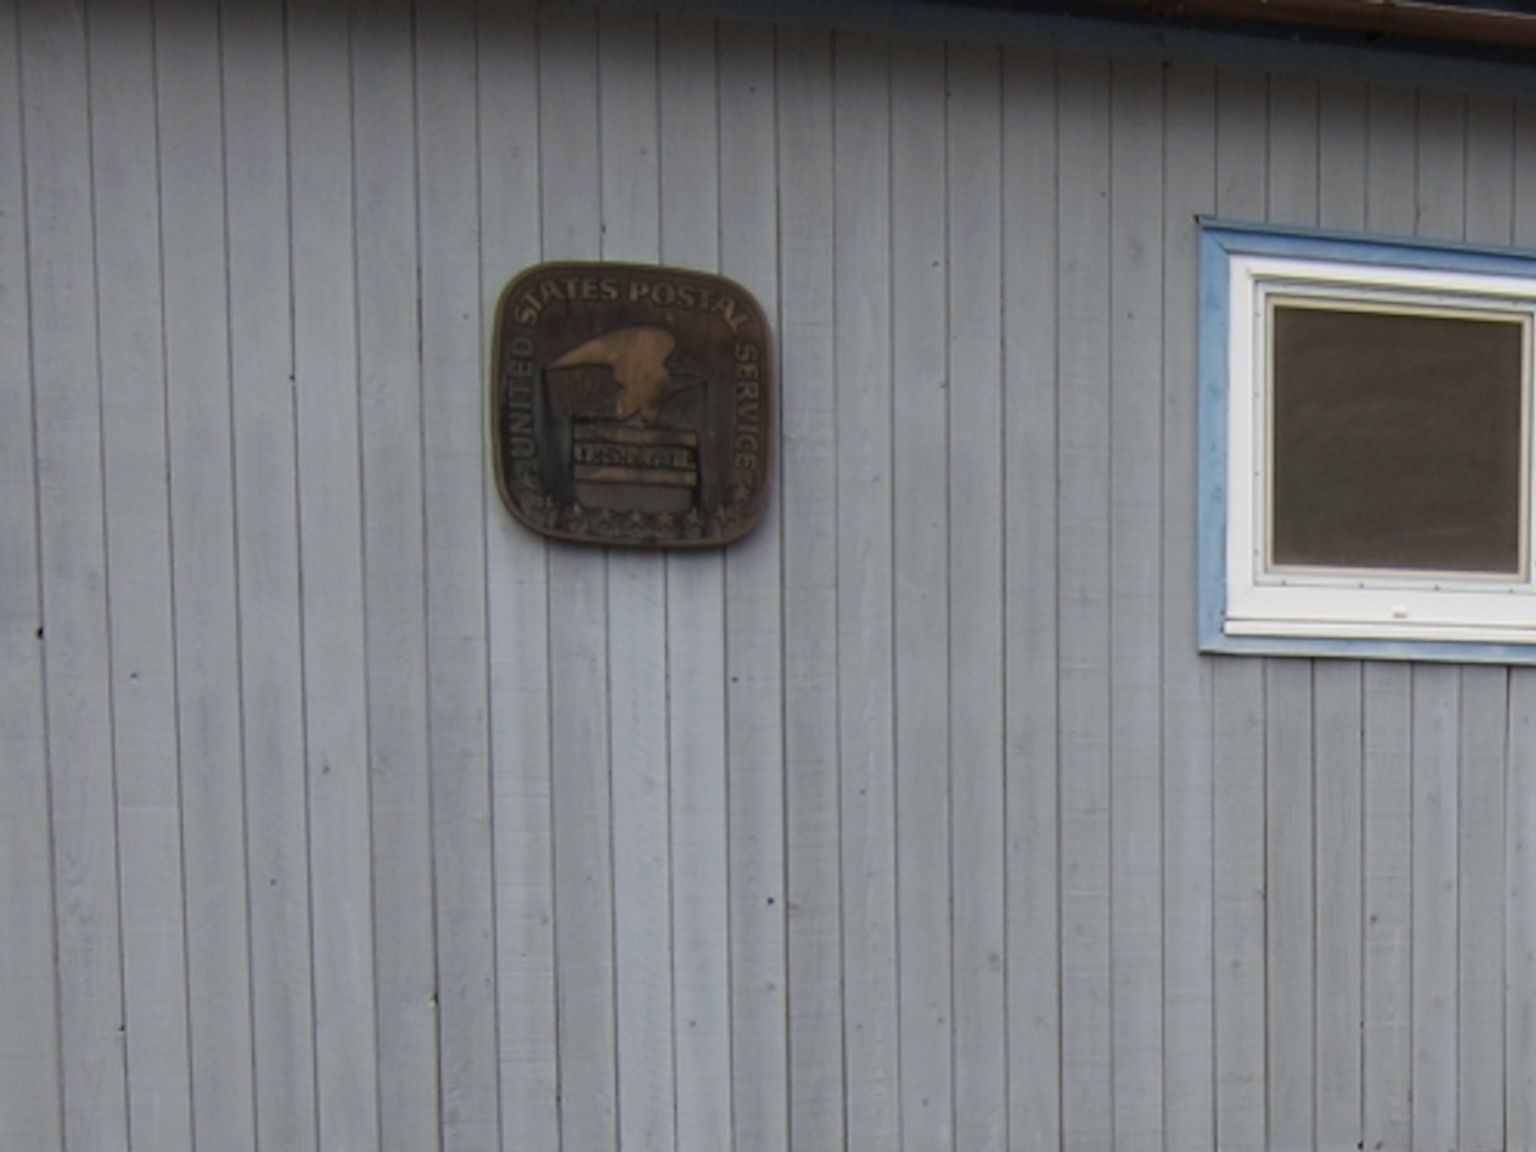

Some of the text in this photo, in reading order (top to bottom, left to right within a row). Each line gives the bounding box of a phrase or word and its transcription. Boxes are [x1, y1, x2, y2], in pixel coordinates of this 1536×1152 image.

[510, 278, 760, 471] UNITED STATES POSTAL SERVICE
